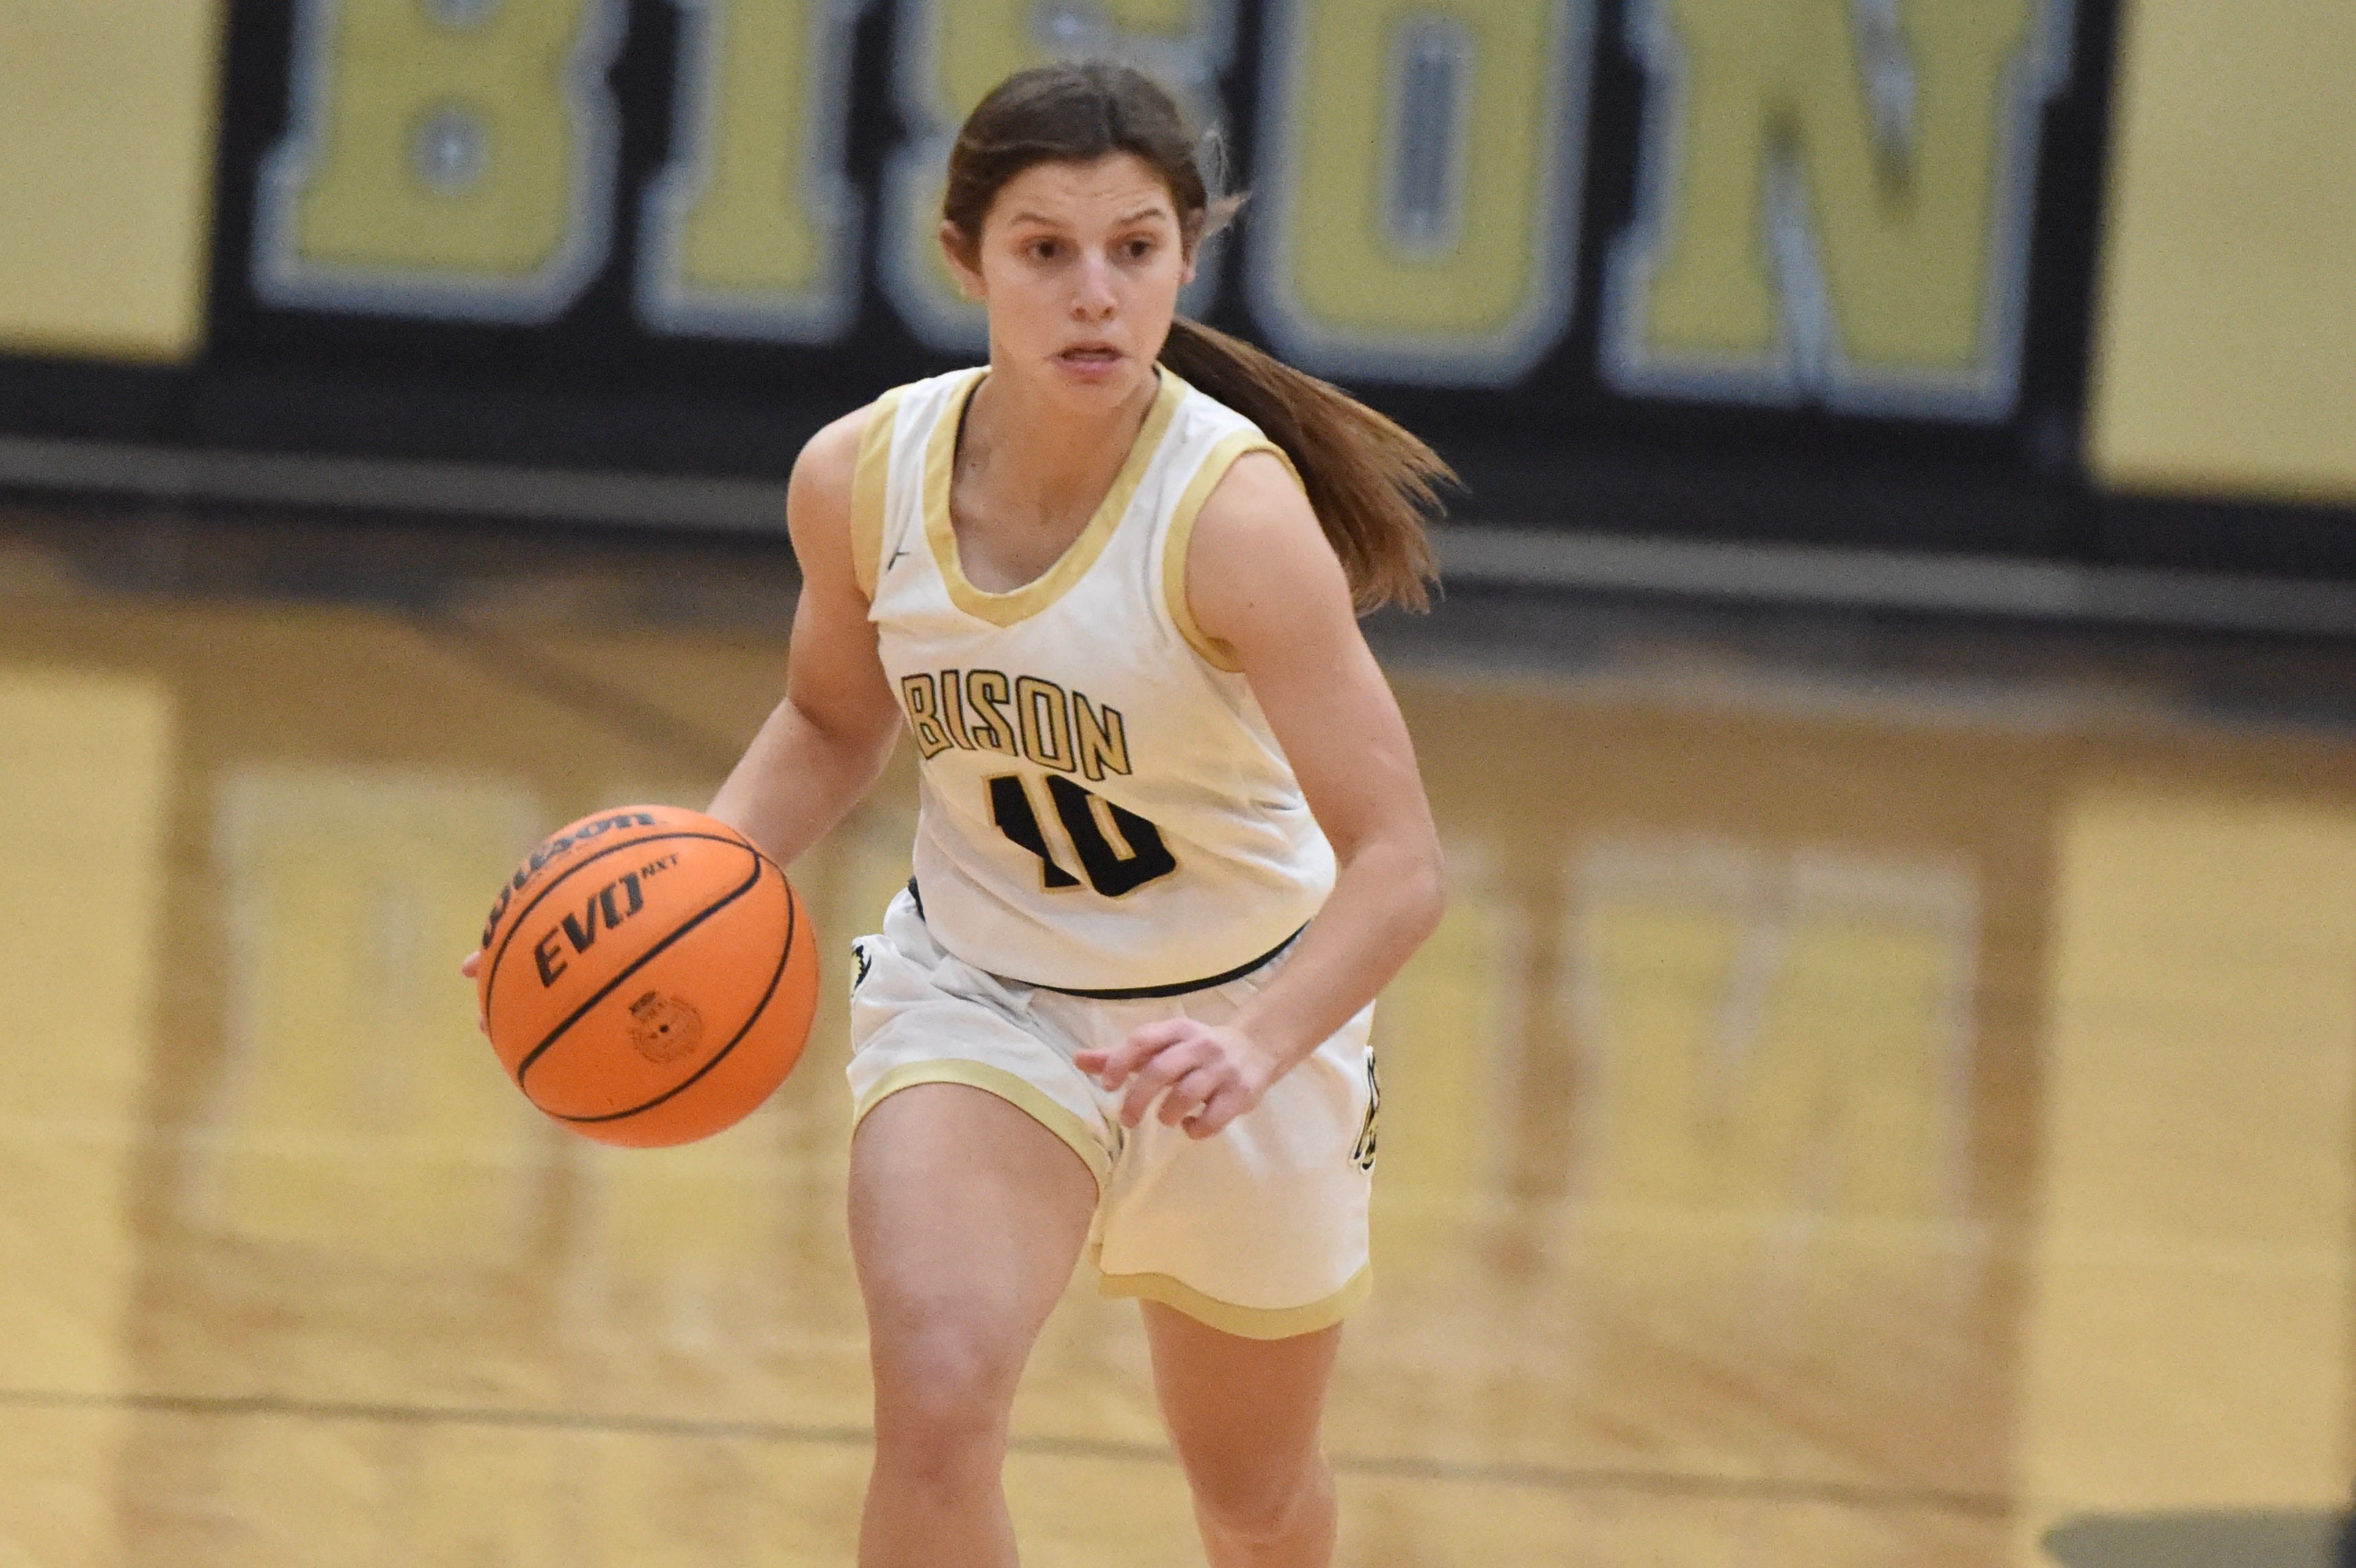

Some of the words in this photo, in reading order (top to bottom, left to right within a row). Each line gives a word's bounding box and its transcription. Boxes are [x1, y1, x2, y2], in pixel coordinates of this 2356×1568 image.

[902, 669, 1133, 781] BISON
[981, 772, 1178, 897] 10
[534, 871, 644, 988] EVO
[641, 853, 679, 880] NXT
